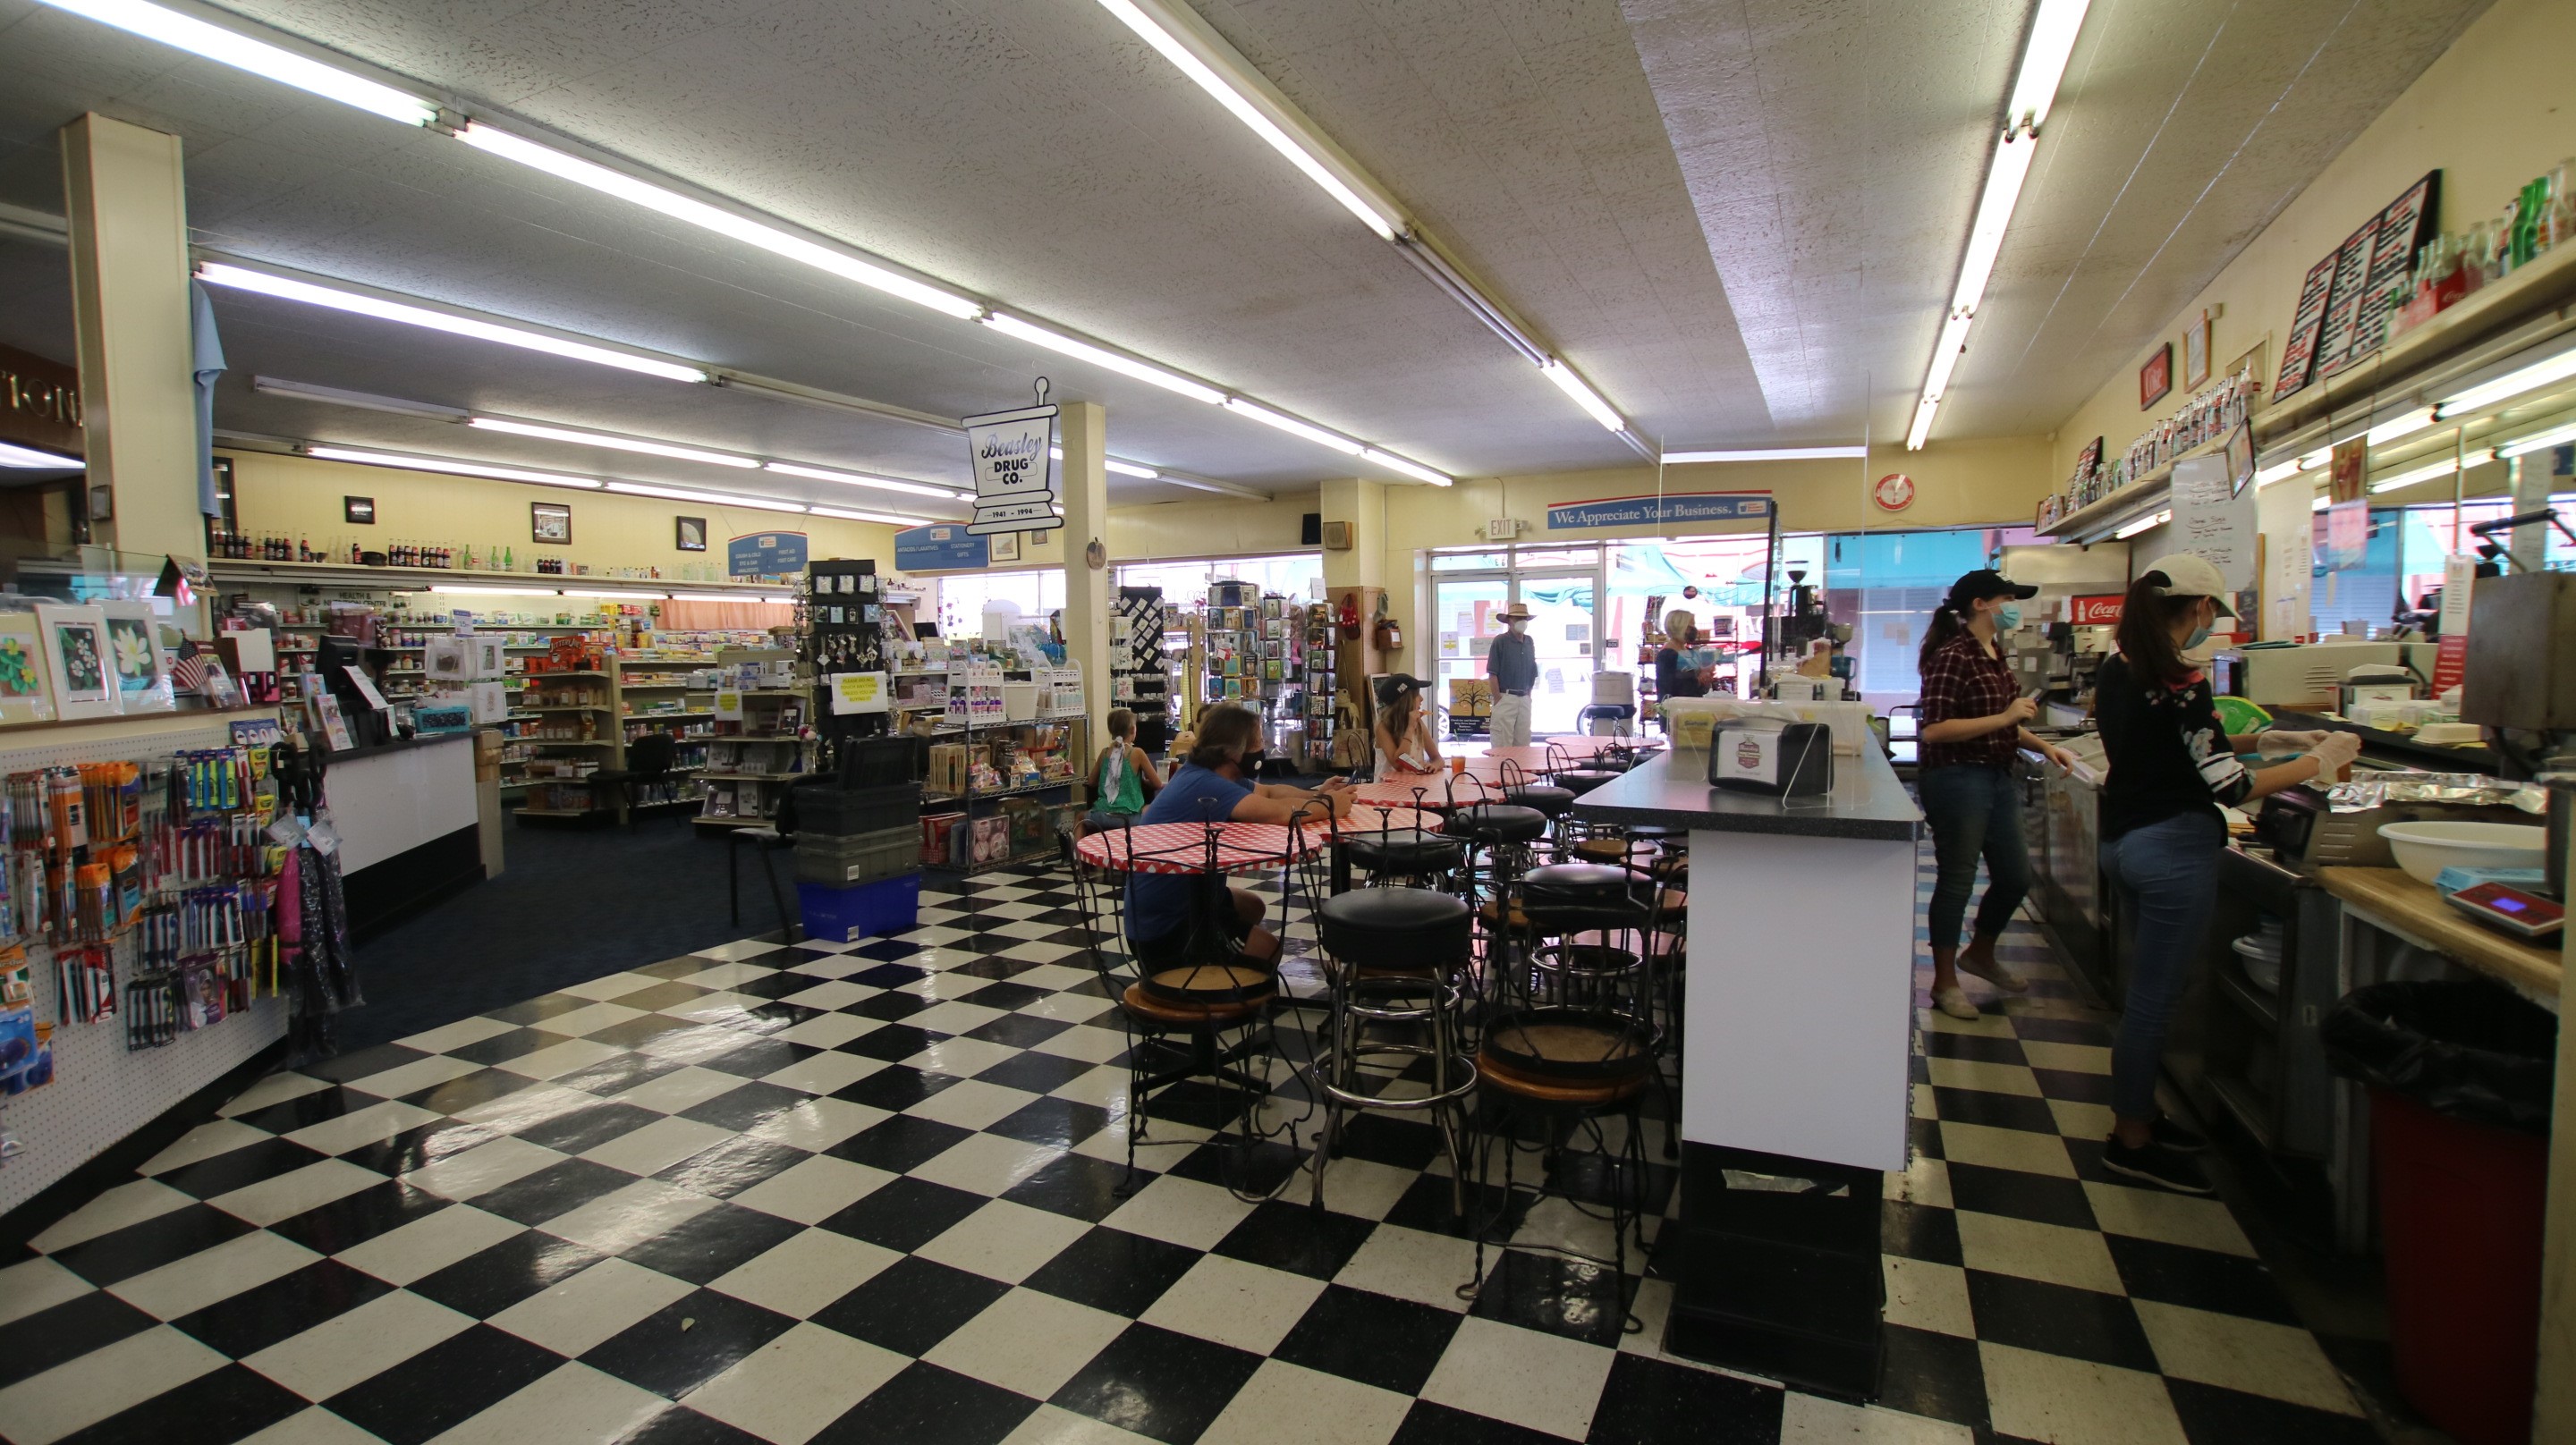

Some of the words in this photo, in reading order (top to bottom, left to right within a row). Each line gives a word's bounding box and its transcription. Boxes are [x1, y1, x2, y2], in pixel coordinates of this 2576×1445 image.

[981, 432, 1042, 461] Beasley
[994, 458, 1029, 473] DRUG
[1002, 472, 1023, 485] CO.
[1555, 511, 1575, 524] We
[1576, 508, 1640, 526] Appreciate
[1643, 505, 1673, 519] Your
[1674, 503, 1733, 517] Business.
[1490, 519, 1512, 537] EXIT
